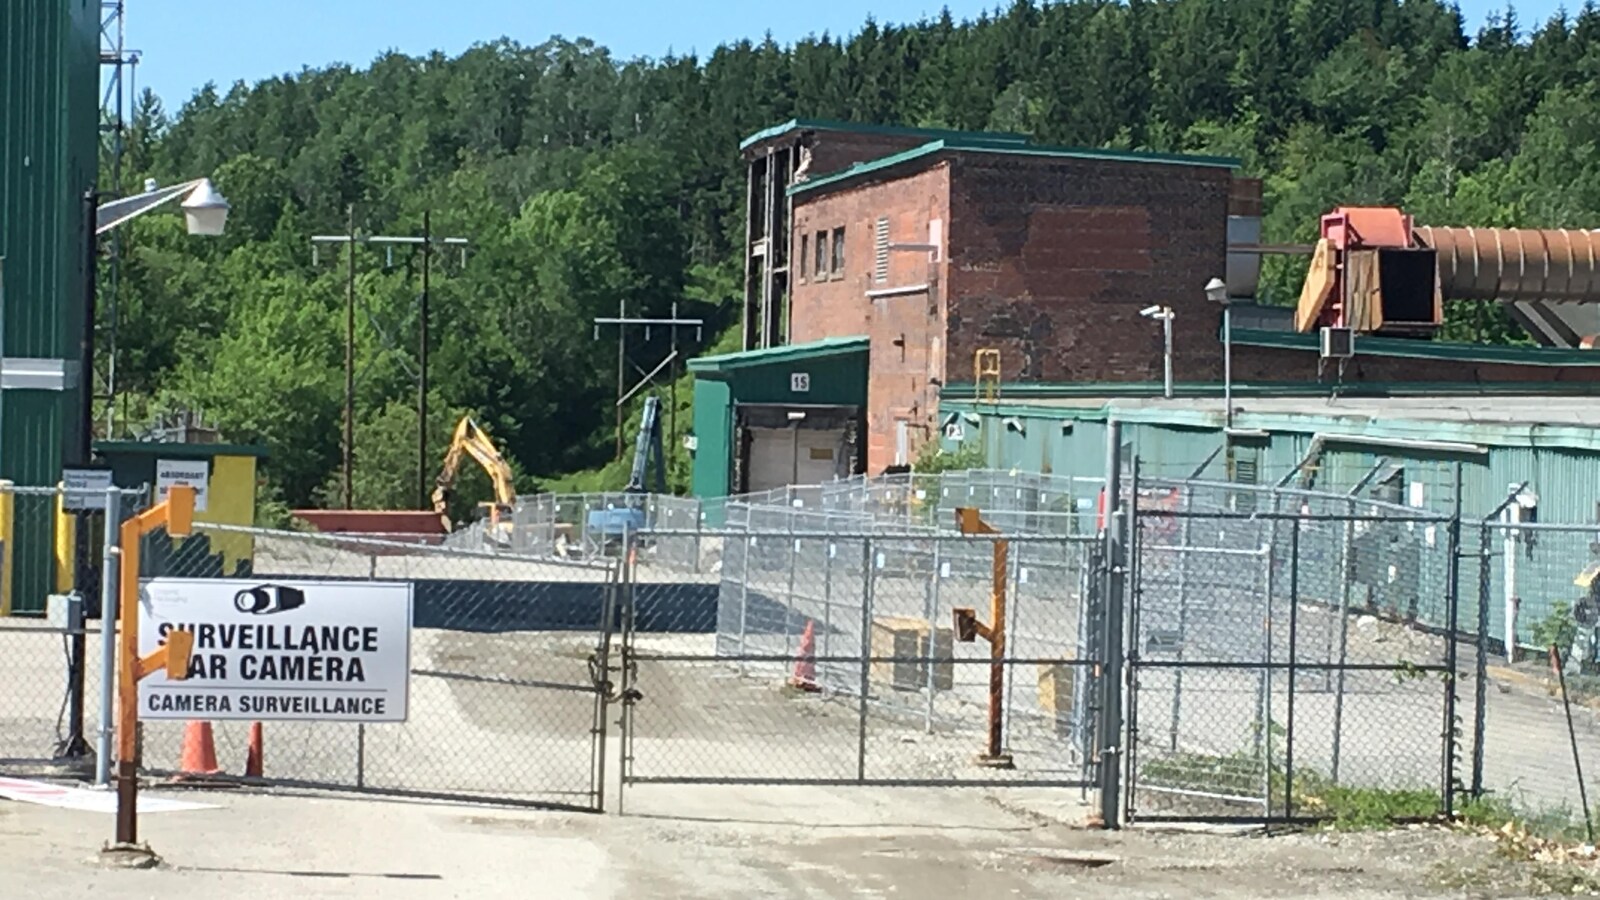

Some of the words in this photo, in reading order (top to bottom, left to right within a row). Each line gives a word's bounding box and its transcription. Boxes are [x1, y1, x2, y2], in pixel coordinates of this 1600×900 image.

[794, 375, 808, 389] 15
[186, 654, 227, 680] AR
[149, 694, 231, 713] CAMERA
[239, 696, 386, 715] SURVEILLANCE
